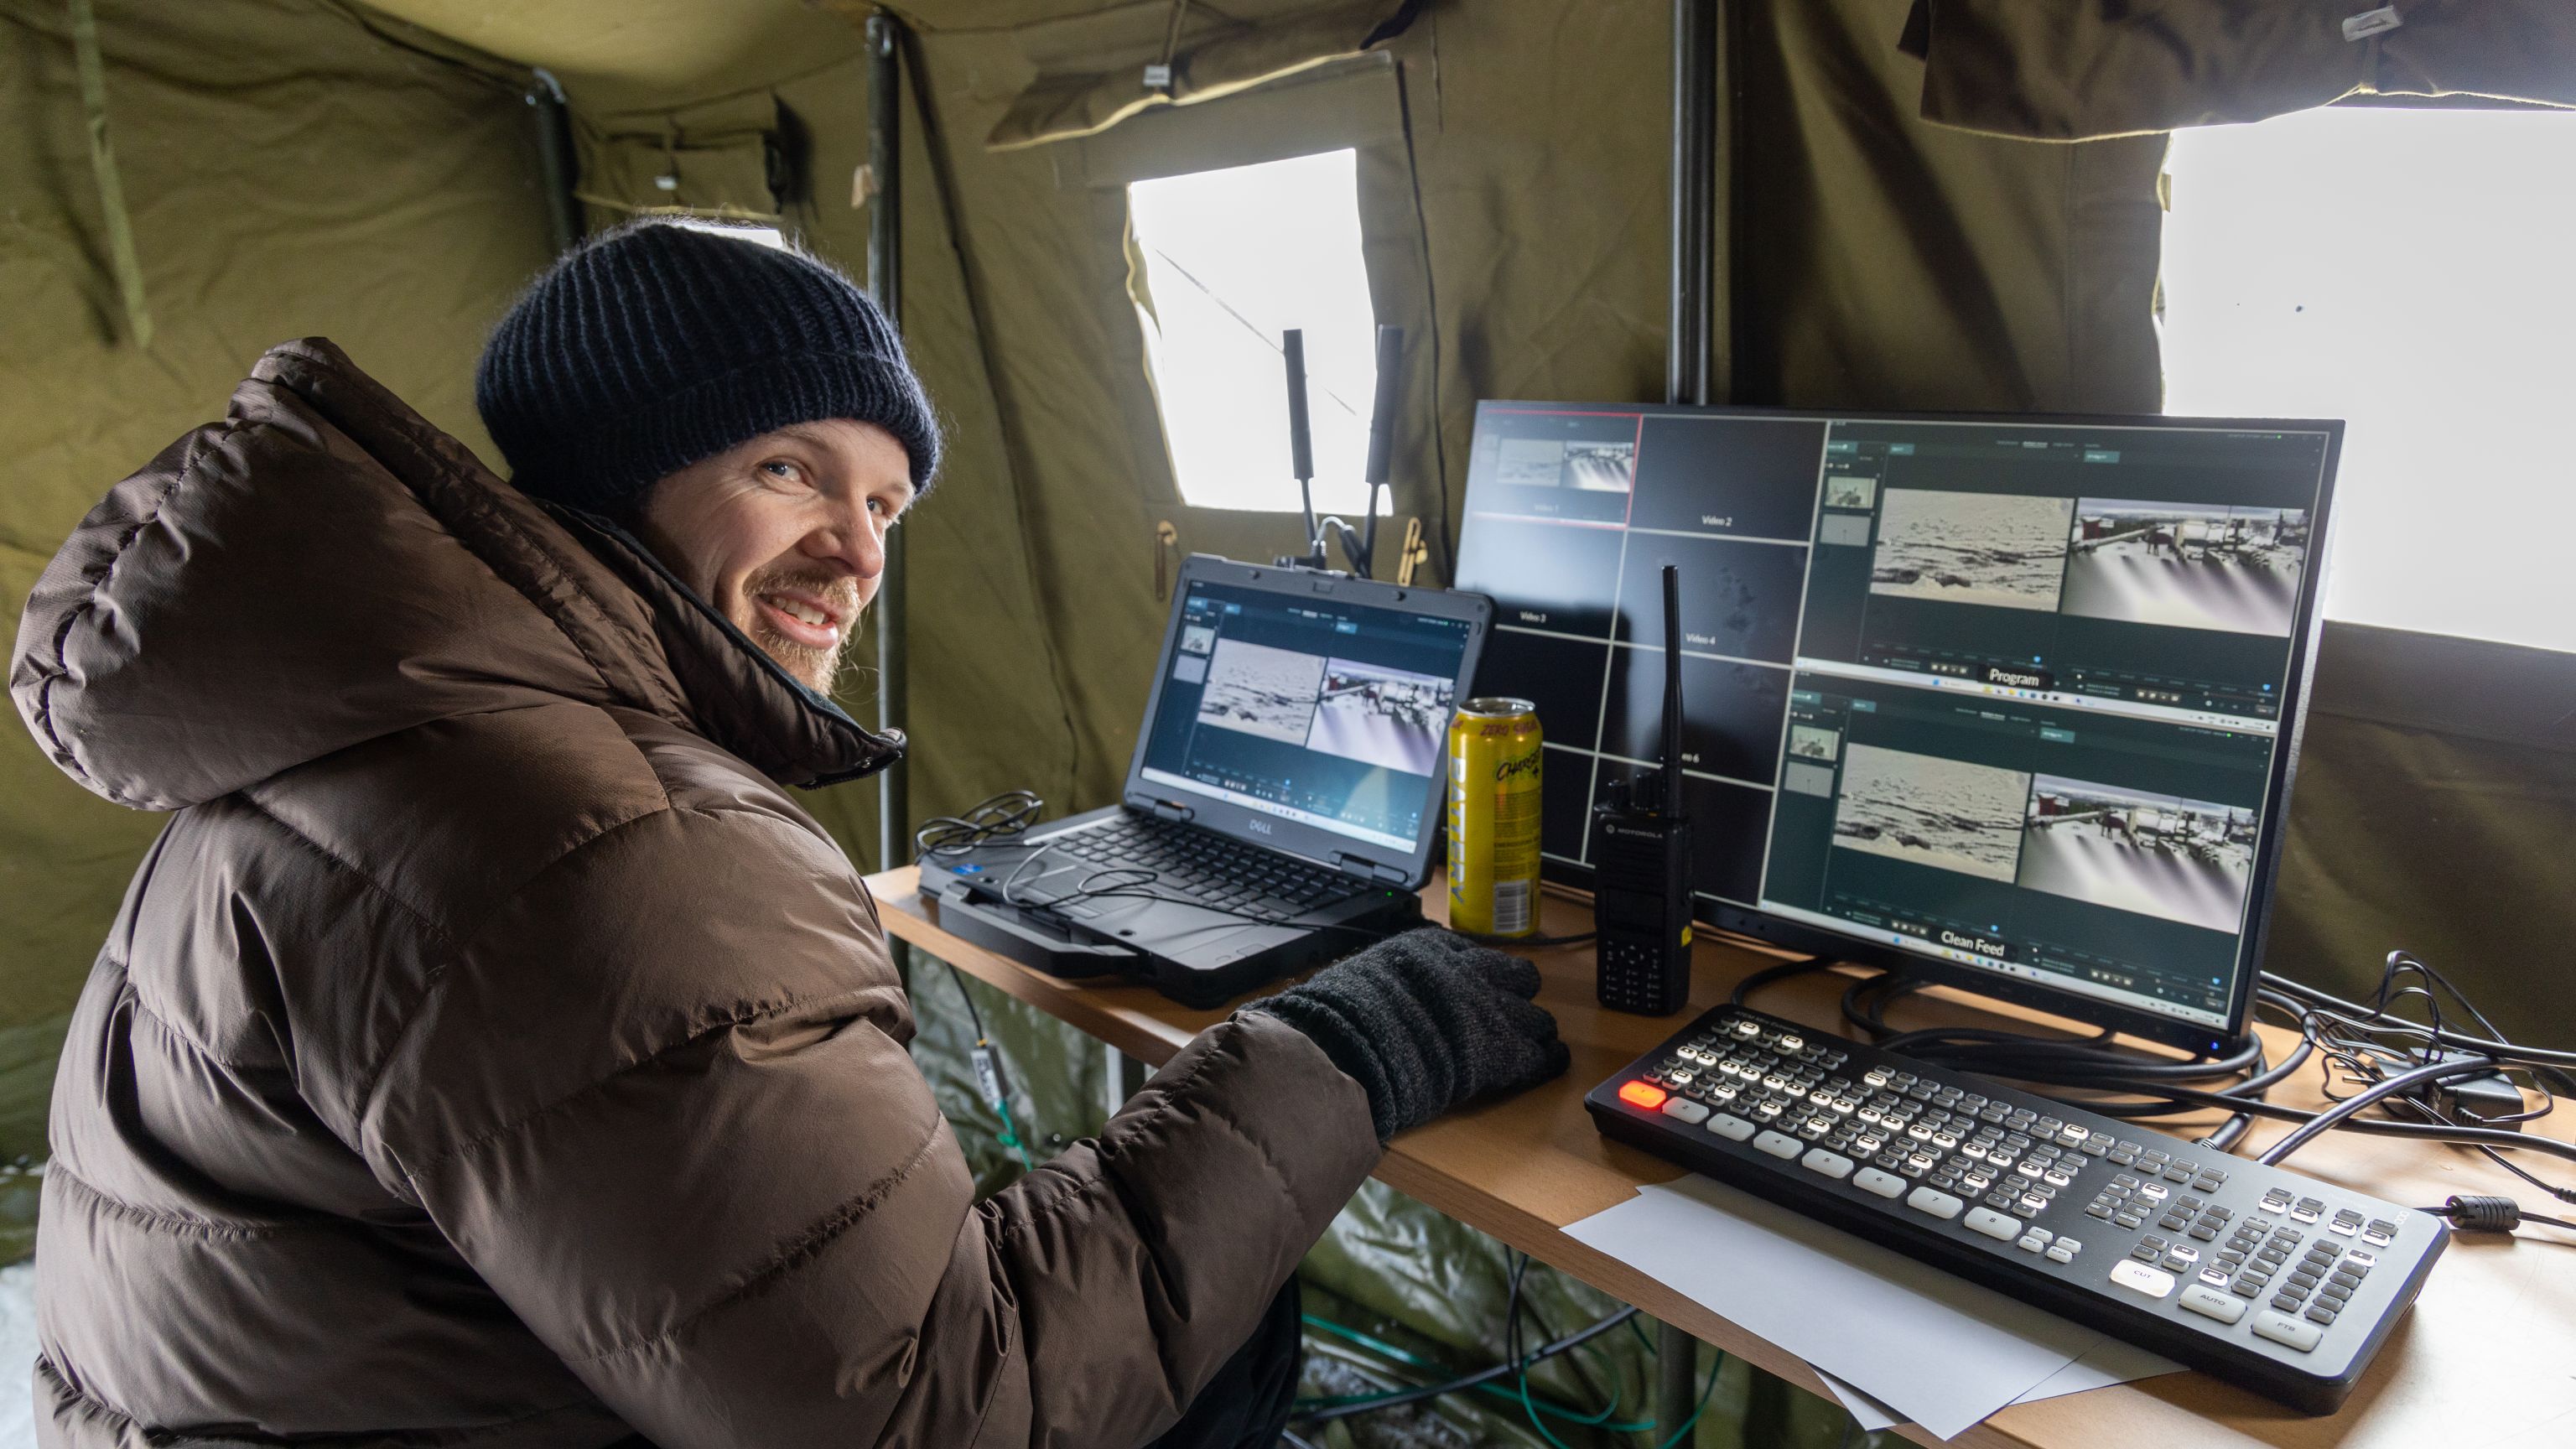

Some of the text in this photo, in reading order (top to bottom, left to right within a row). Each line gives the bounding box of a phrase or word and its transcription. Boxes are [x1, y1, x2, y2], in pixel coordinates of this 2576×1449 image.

[1701, 515, 1732, 527] Video 2
[1519, 610, 1546, 624] Video 3
[1685, 633, 1716, 645] Video 4
[1989, 667, 2039, 687] Program
[1479, 723, 1509, 737] ZERO
[1249, 818, 1272, 835] DELL
[1449, 756, 1467, 906] BATTERY
[1617, 828, 1664, 839] MOTOROLA
[1940, 930, 2005, 957] Clean Feed
[2335, 1220, 2351, 1229] STOP
[2133, 1270, 2152, 1279] CUT
[2199, 1293, 2226, 1306] AUTO
[2277, 1321, 2296, 1332] FTB
